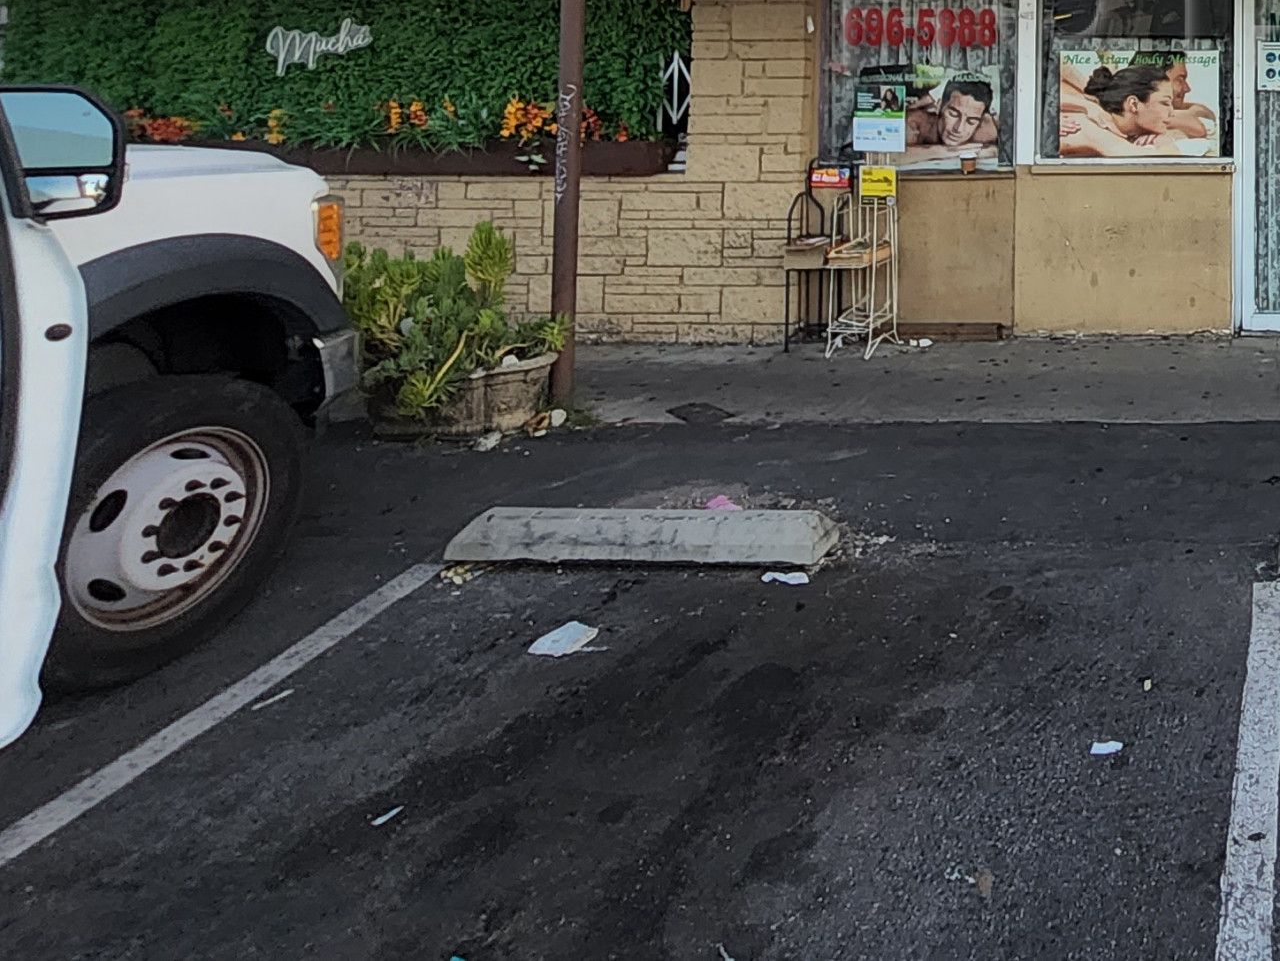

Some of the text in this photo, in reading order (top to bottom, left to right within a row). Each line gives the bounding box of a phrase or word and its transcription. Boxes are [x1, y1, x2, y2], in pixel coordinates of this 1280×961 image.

[844, 6, 997, 48] 696-5888
[1063, 54, 1091, 65] Nice
[1134, 53, 1164, 68] Body
[1167, 53, 1217, 67] Massage
